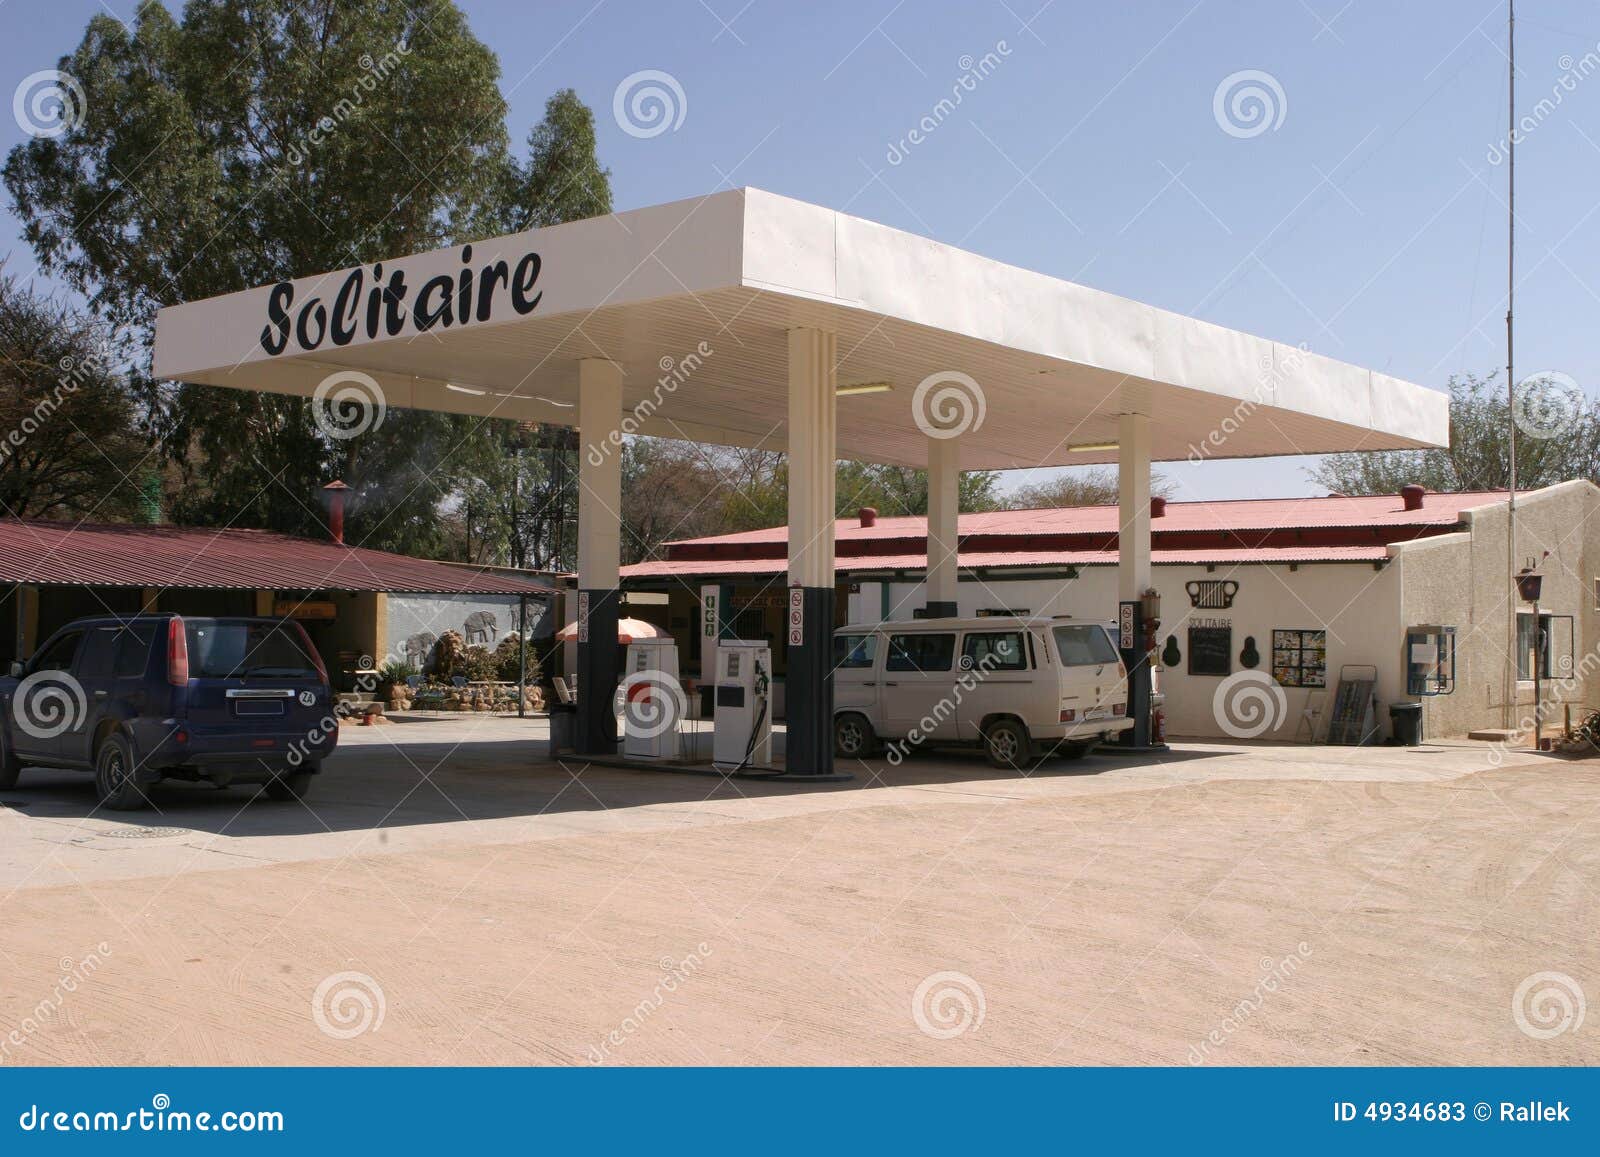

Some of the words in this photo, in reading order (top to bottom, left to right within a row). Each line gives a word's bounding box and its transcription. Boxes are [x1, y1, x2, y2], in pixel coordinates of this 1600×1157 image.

[261, 244, 542, 356] Solitaire
[1189, 617, 1232, 629] SOLITAIRE
[302, 692, 313, 704] ZA
